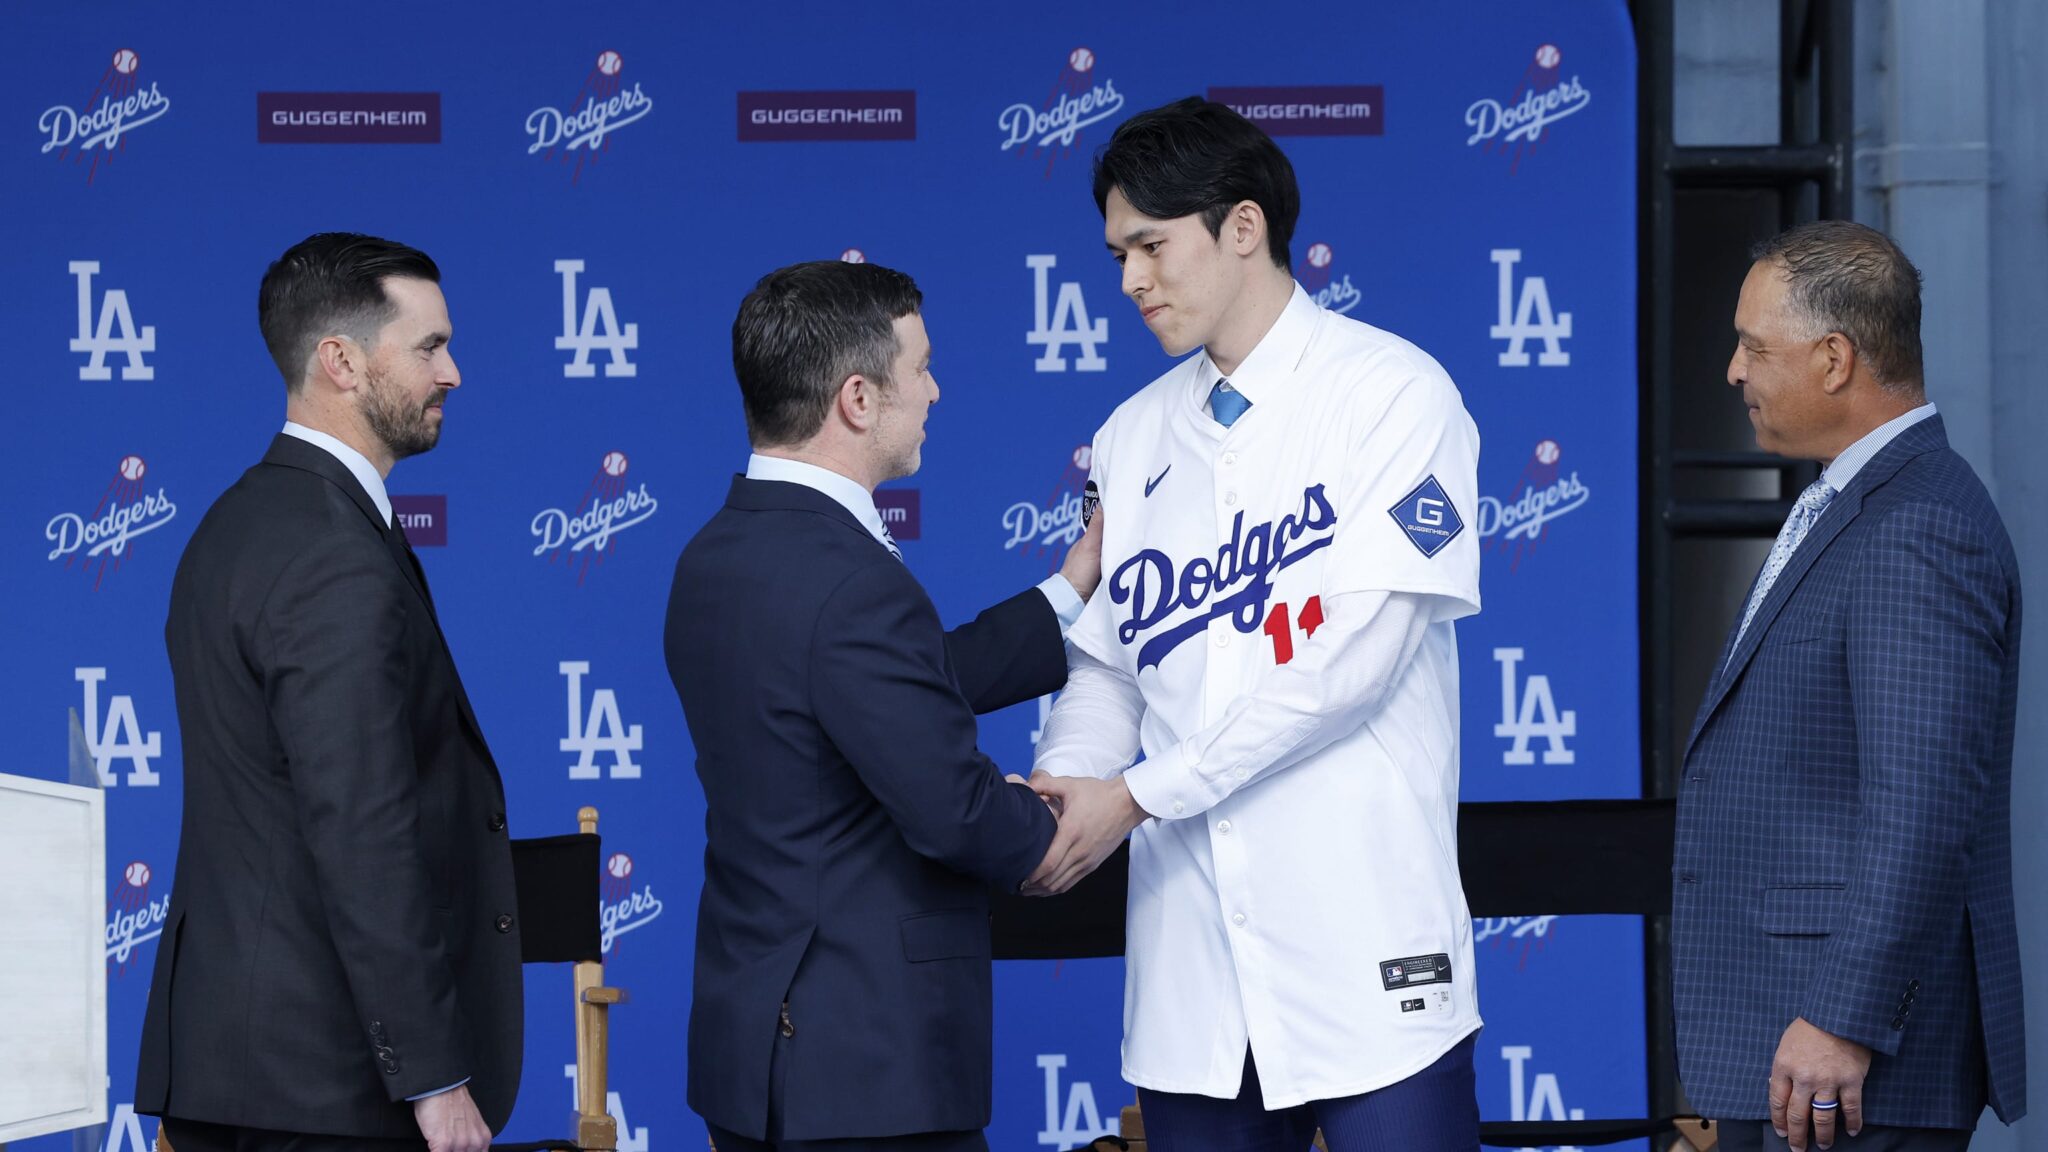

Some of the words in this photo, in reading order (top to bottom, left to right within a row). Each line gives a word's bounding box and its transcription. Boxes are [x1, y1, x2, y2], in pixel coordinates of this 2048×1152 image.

[38, 81, 170, 154] Dodgers
[272, 110, 427, 126] GUGGENHEIM
[525, 82, 653, 154] Dodgers
[751, 108, 903, 124] GUGGENHEIM
[998, 79, 1124, 151] Dodgers
[1465, 76, 1591, 146] Dodgers
[68, 260, 156, 381] LA
[554, 259, 639, 378] LA
[1025, 254, 1109, 373] LA
[1489, 248, 1573, 367] LA
[45, 487, 177, 561] Dodgers
[530, 483, 658, 556] Dodgers
[1002, 492, 1083, 550] Dodg
[1407, 524, 1450, 536] GUGGENHEIM
[1416, 497, 1444, 526] G
[1478, 471, 1590, 540] Dodgers
[75, 667, 161, 786] LA
[558, 660, 643, 780] LA
[1492, 647, 1577, 766] LA
[106, 894, 169, 963] dgers
[600, 885, 663, 954] gers
[1037, 1054, 1119, 1152] LA
